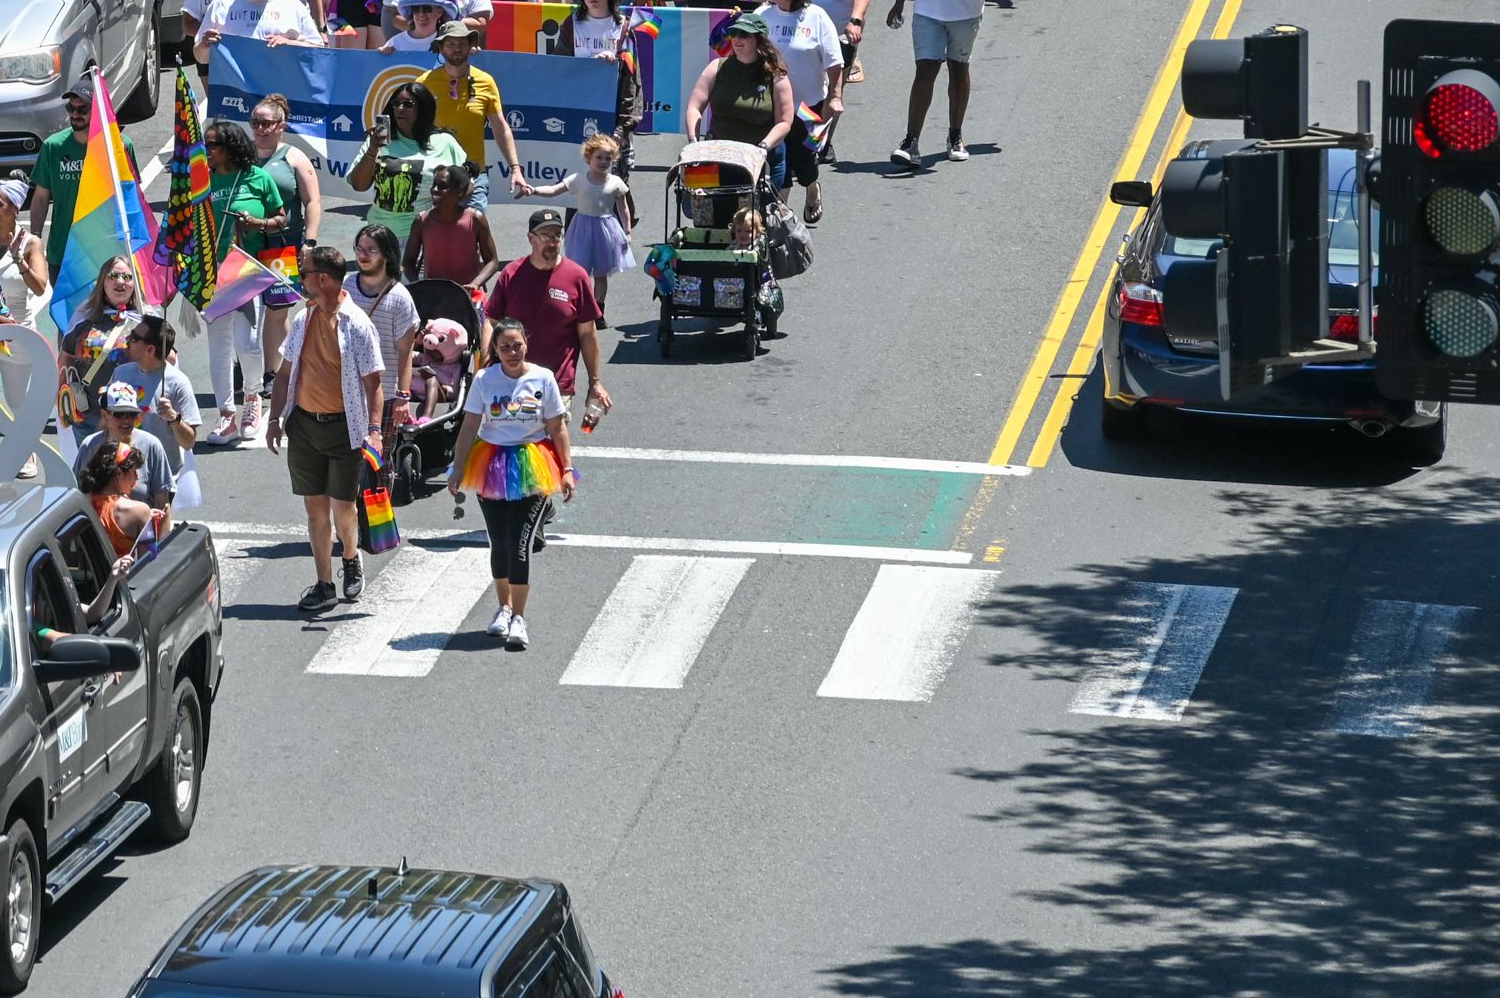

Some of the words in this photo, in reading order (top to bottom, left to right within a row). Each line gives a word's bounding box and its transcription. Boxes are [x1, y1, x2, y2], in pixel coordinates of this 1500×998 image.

[230, 10, 250, 21] LIVE
[251, 10, 280, 21] UNITED
[767, 25, 781, 37] IVE
[782, 25, 812, 38] UNITED
[575, 37, 592, 50] LIVE
[59, 160, 85, 172] M&T
[518, 521, 532, 562] UNDER
